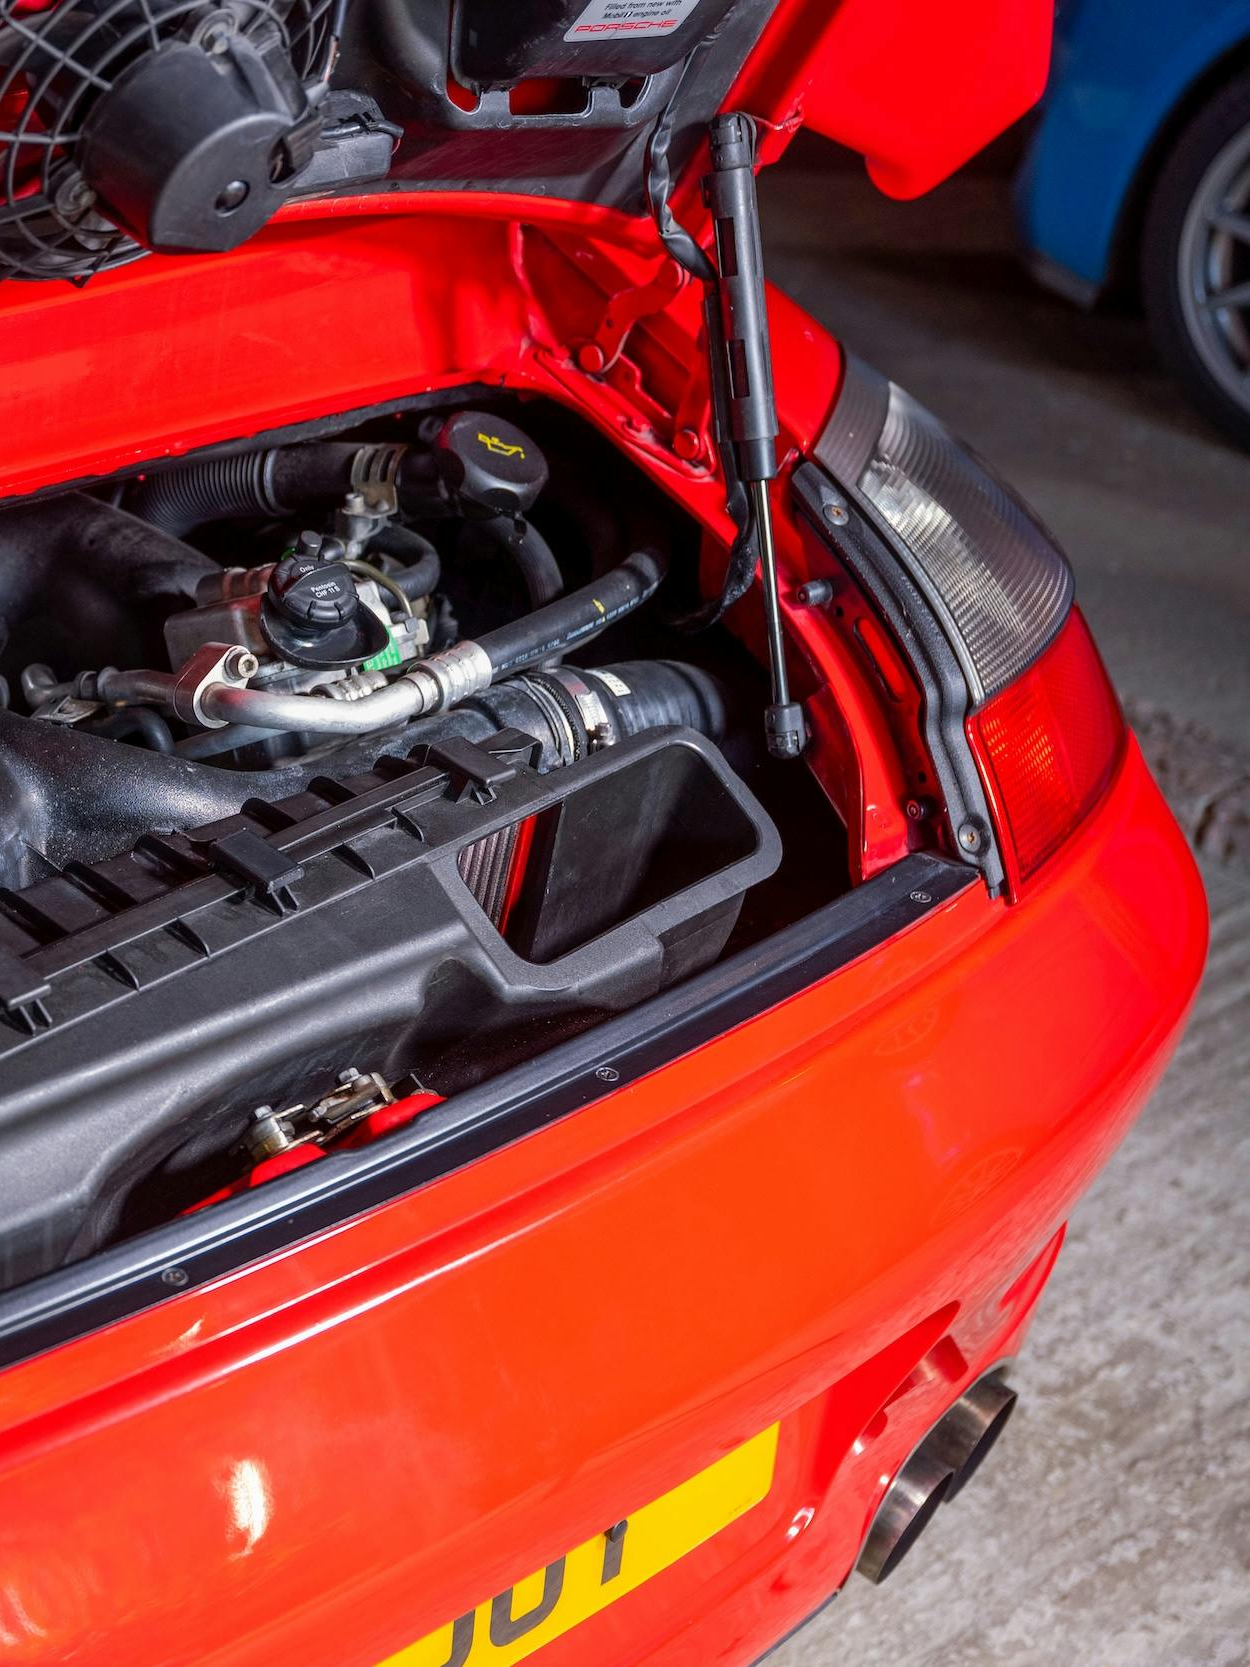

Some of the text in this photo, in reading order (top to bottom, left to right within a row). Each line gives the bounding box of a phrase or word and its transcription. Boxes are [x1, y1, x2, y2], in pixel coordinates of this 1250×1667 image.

[604, 2, 627, 10] Filled
[627, 1, 647, 9] from
[632, 10, 660, 18] engine
[574, 19, 679, 33] PORSCHE
